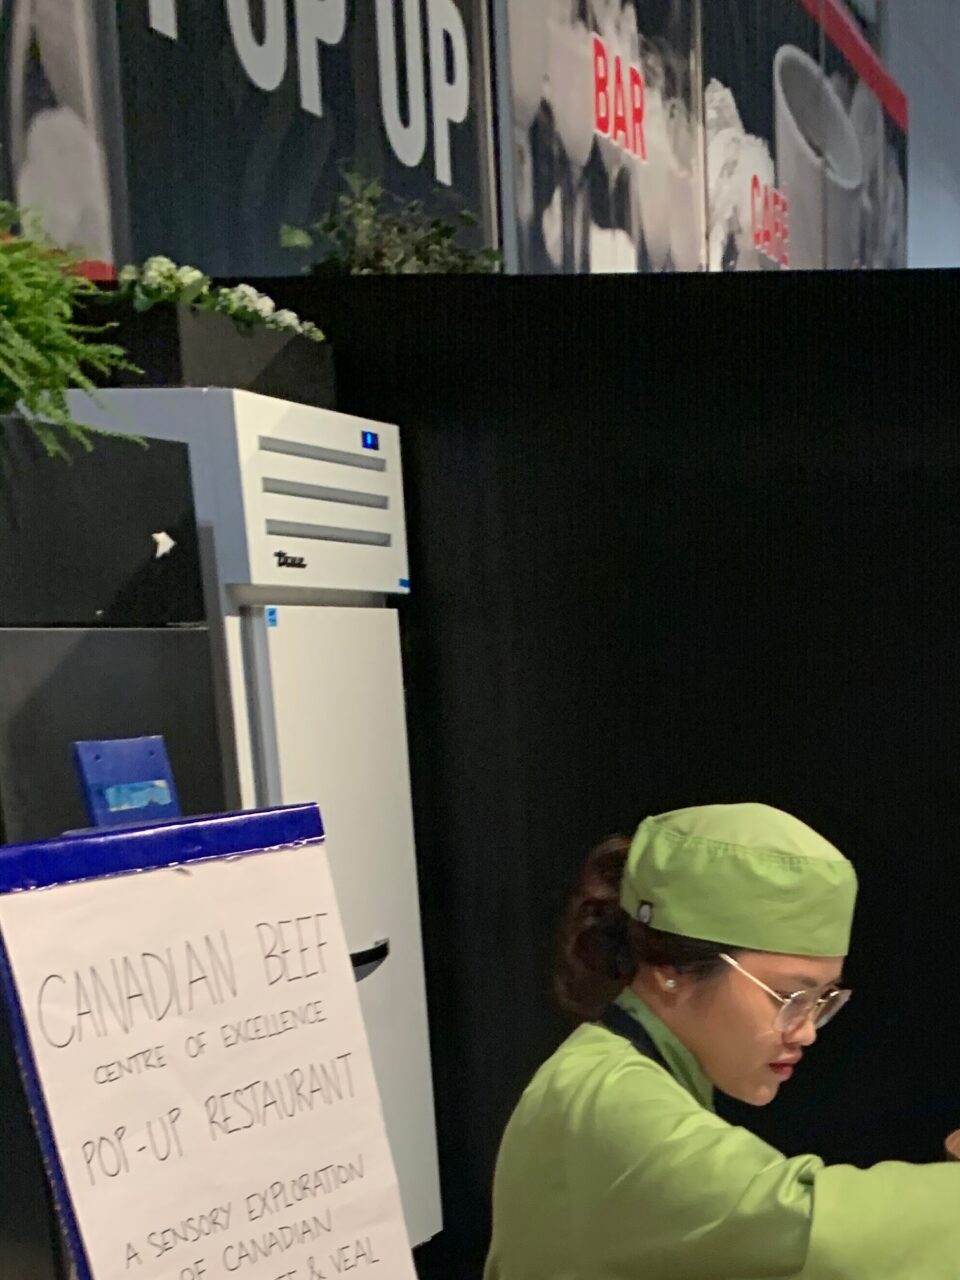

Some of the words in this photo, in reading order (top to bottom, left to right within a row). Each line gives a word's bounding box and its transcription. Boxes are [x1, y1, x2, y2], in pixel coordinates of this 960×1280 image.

[376, 0, 469, 186] UP
[593, 37, 647, 163] BAR
[37, 930, 237, 1049] CANADIAN
[256, 913, 329, 986] BEEF
[94, 1045, 168, 1085] CENTRE
[185, 1031, 207, 1058] OF
[223, 1001, 327, 1048] EXCELLENCE
[81, 1107, 185, 1186] POP-UP
[204, 1053, 356, 1141] RESTAURANT
[124, 1243, 141, 1269] A
[147, 1203, 233, 1258] SENSORY
[246, 1154, 365, 1222] EXPLORATION
[222, 1209, 333, 1272] CANADIAN
[330, 1236, 380, 1275] VEAL
